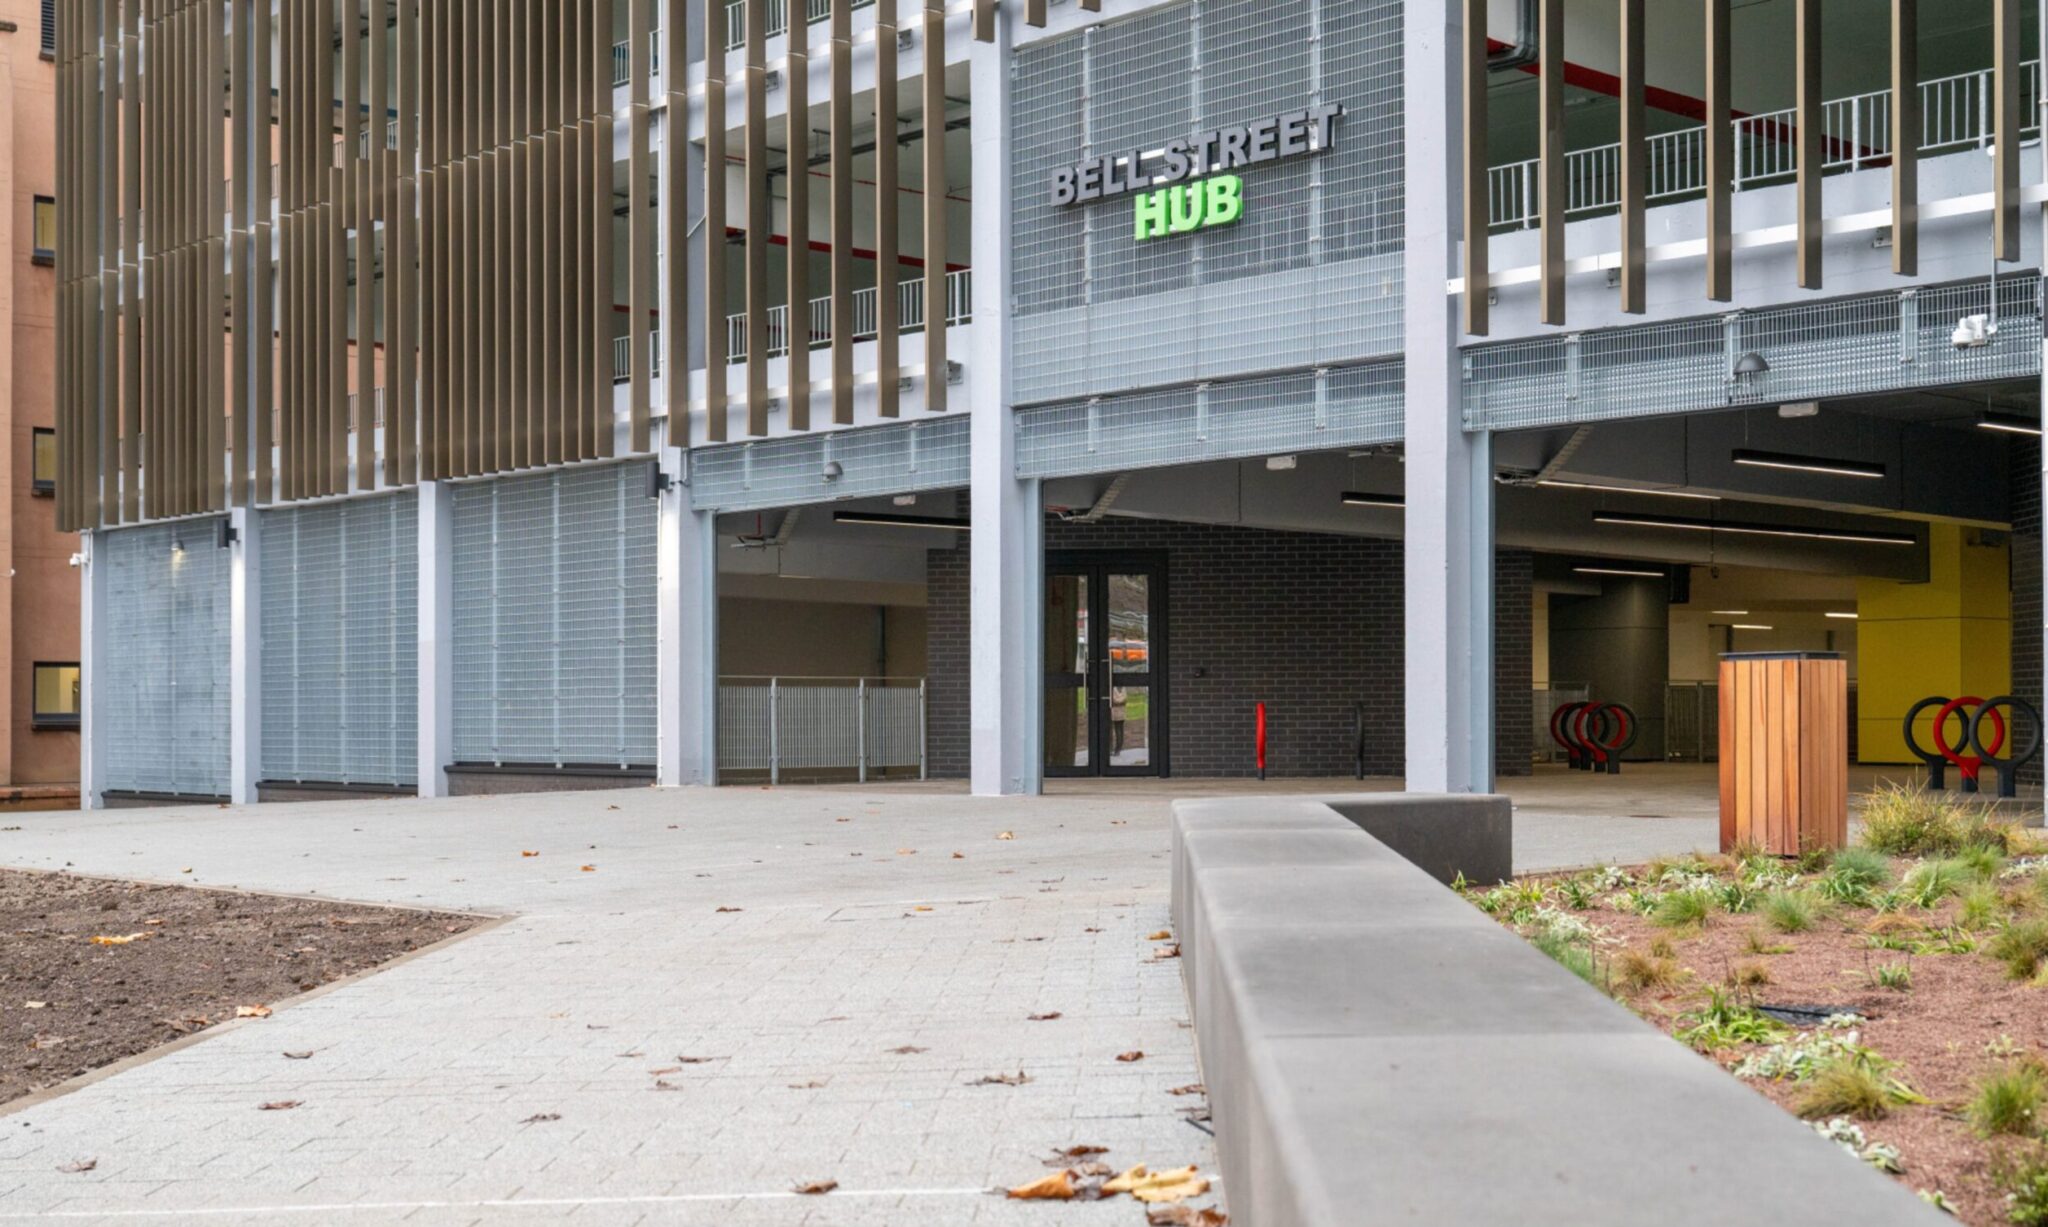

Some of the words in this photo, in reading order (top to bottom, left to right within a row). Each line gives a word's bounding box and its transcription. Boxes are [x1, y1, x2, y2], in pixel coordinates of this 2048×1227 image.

[1050, 150, 1150, 207] BELL
[1163, 103, 1344, 182] STREET
[1135, 174, 1242, 240] HUB
